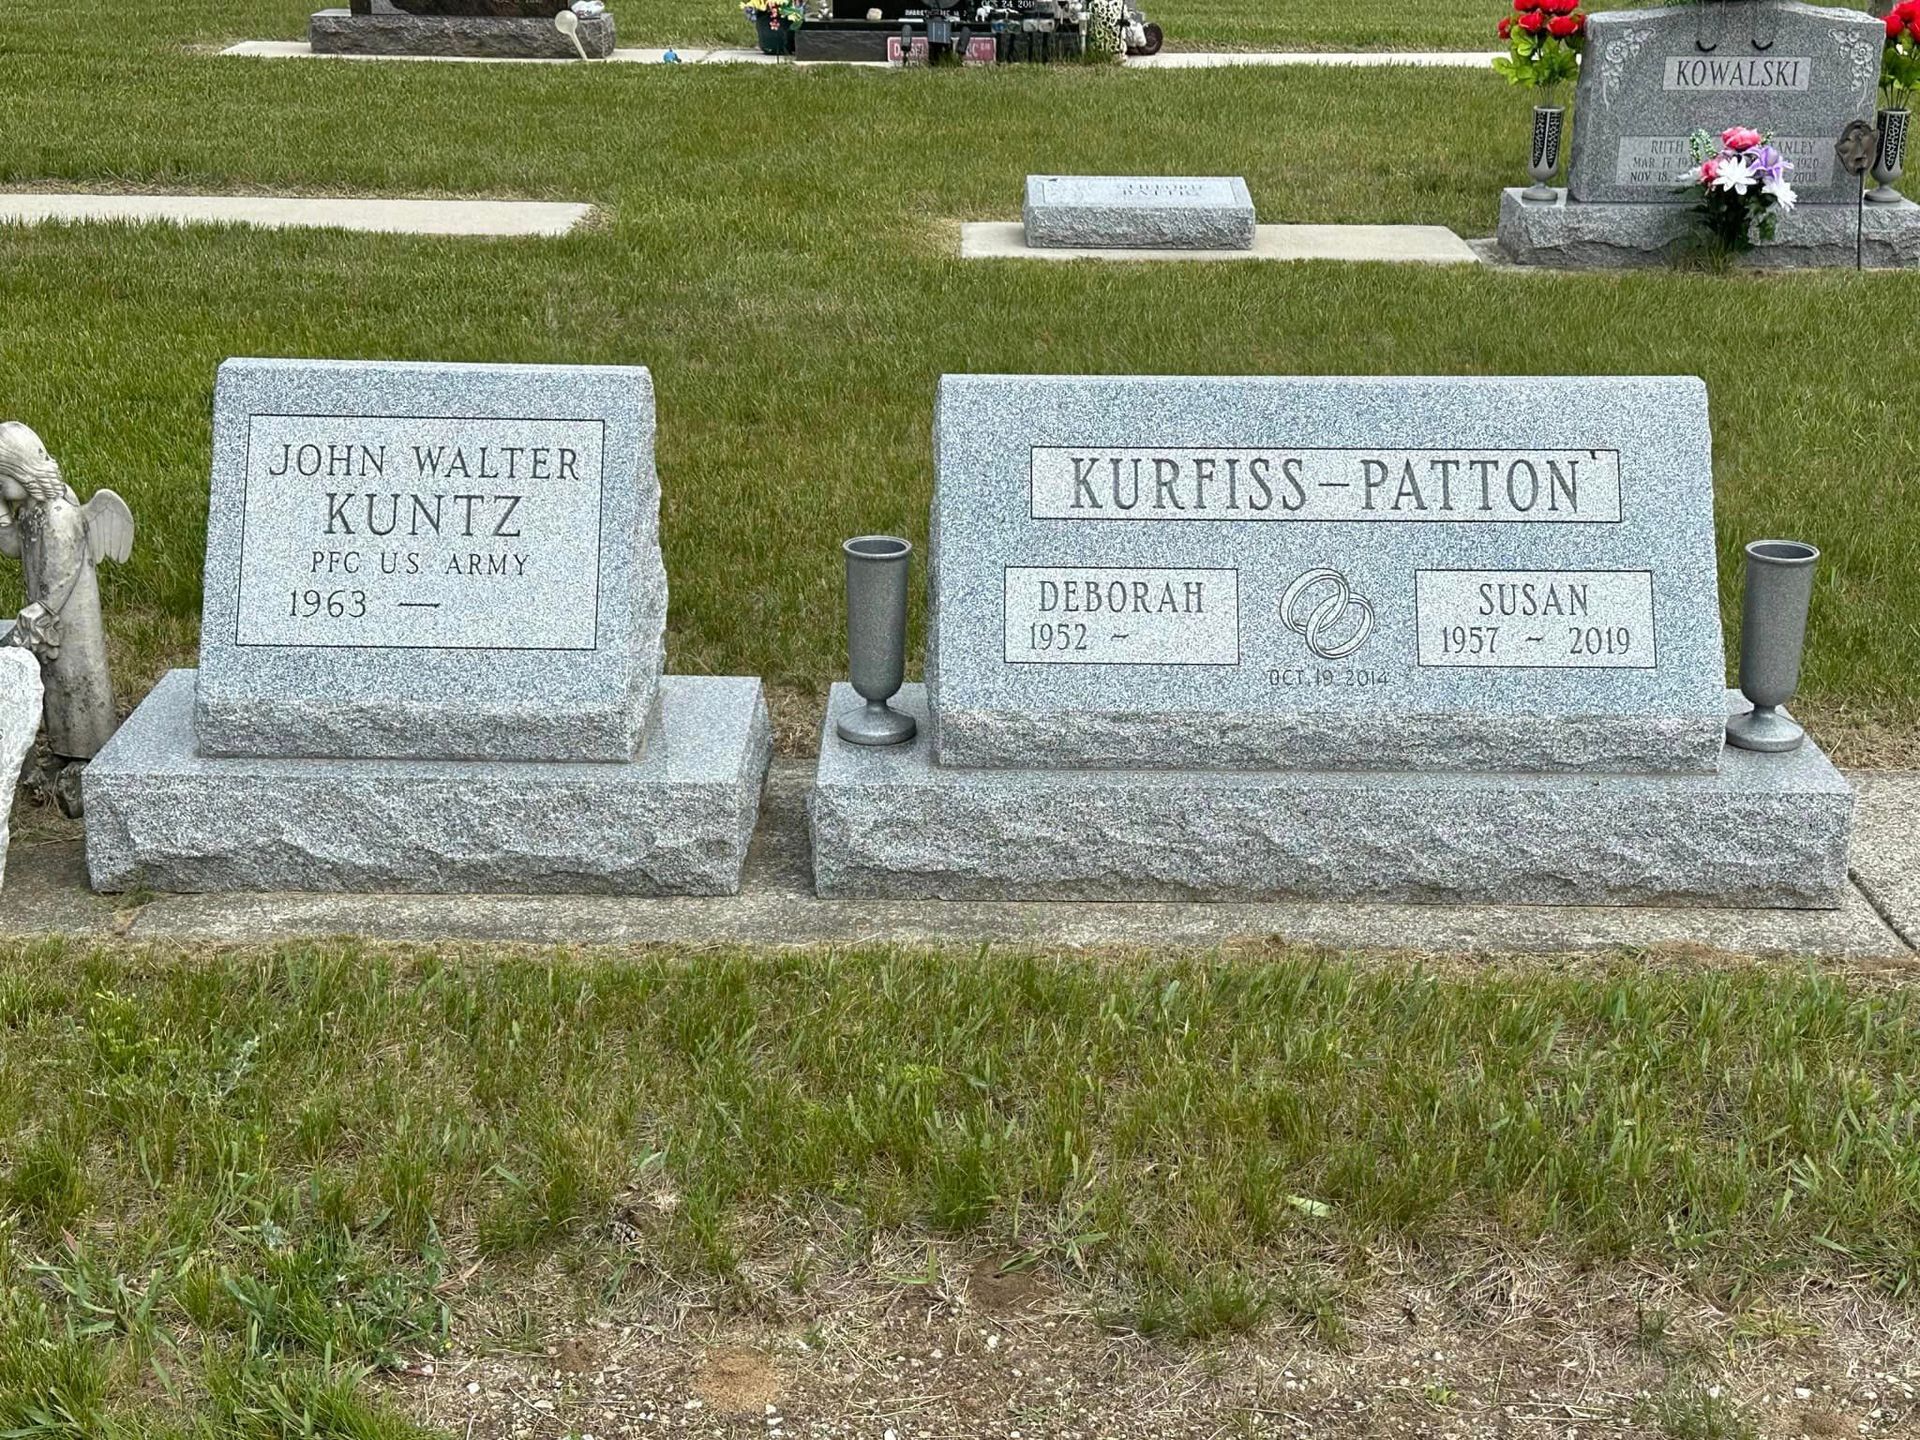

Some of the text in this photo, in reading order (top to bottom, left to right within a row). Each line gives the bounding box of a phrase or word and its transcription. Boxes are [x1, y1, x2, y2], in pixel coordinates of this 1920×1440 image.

[1676, 60, 1799, 87] KOWALSKI
[1651, 140, 1684, 154] RUTH
[1770, 141, 1816, 155] ANLEY
[269, 444, 580, 481] JOHN WALTER
[322, 492, 523, 537] KUNTZ
[310, 551, 360, 574] PFC
[445, 553, 530, 576] ARMY
[288, 589, 367, 618] 1963
[1038, 580, 1204, 613] DEBORAH
[1478, 583, 1589, 616] SUSAN
[1029, 623, 1088, 651] 1952
[1441, 626, 1498, 654] 1957
[1568, 627, 1630, 655] 2019
[1346, 669, 1389, 687] 2014
